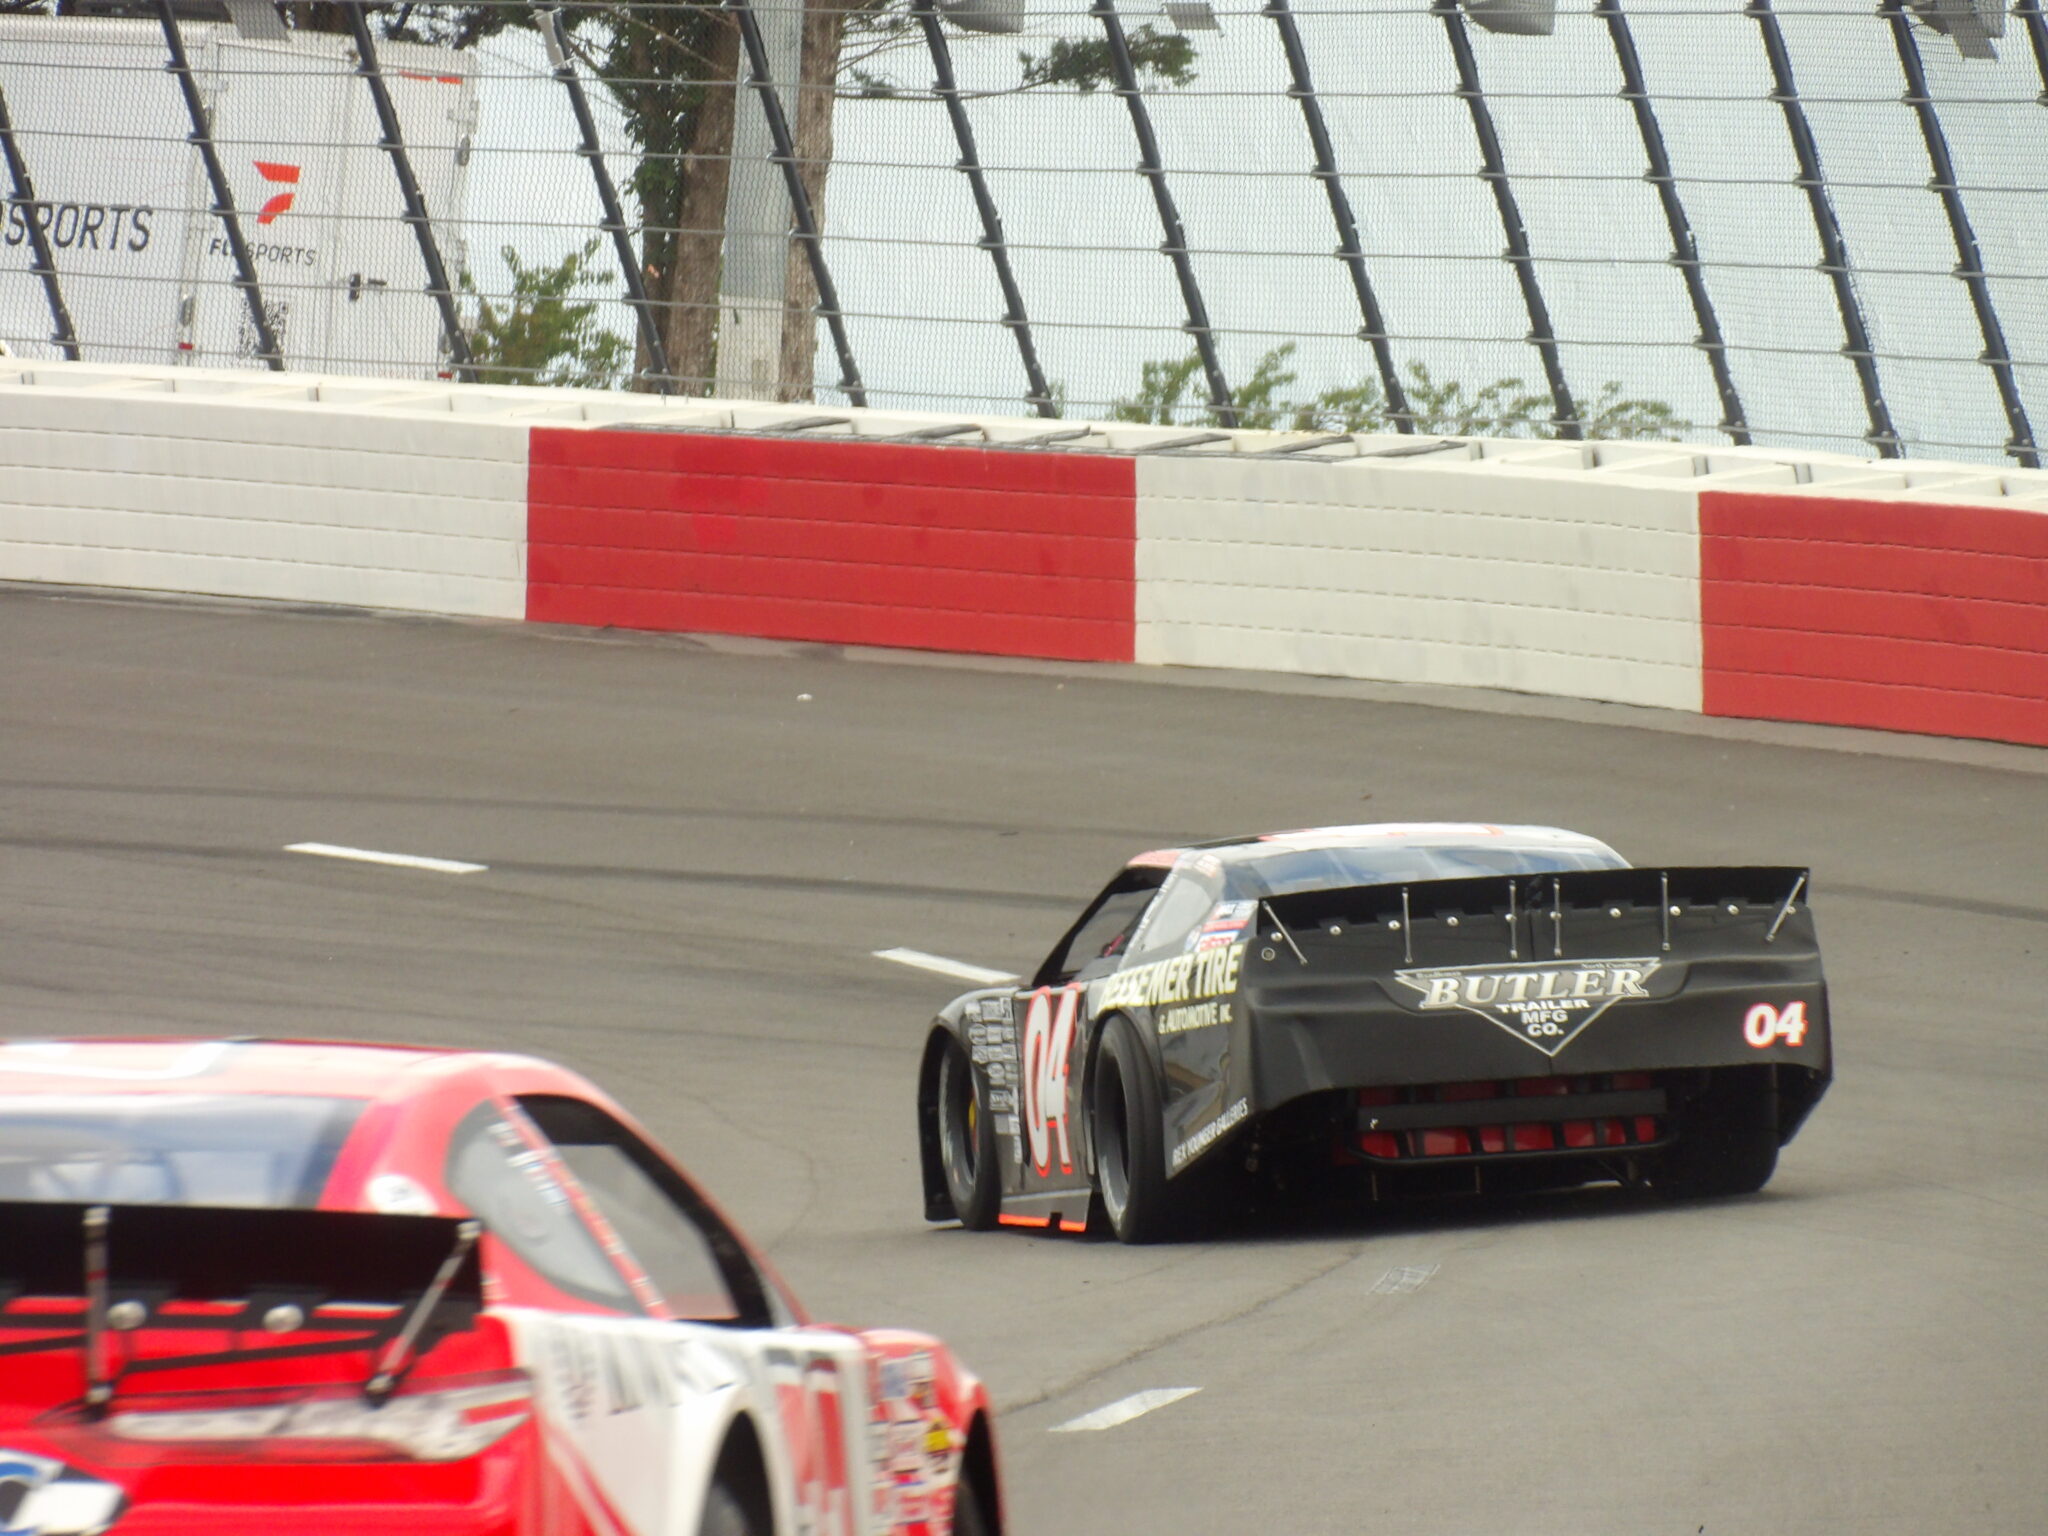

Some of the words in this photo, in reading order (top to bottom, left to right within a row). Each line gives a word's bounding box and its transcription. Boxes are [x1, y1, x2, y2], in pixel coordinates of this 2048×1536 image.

[0, 201, 153, 252] SPORTS
[208, 238, 316, 266] FLSPORTS
[1194, 944, 1244, 998] TIRE
[1419, 968, 1649, 1009] BUTLER
[1495, 998, 1591, 1013] TRAILER
[1521, 1009, 1569, 1024] MFG
[1743, 1000, 1809, 1048] 04
[1527, 1022, 1565, 1037] CO.
[1025, 983, 1080, 1177] 04
